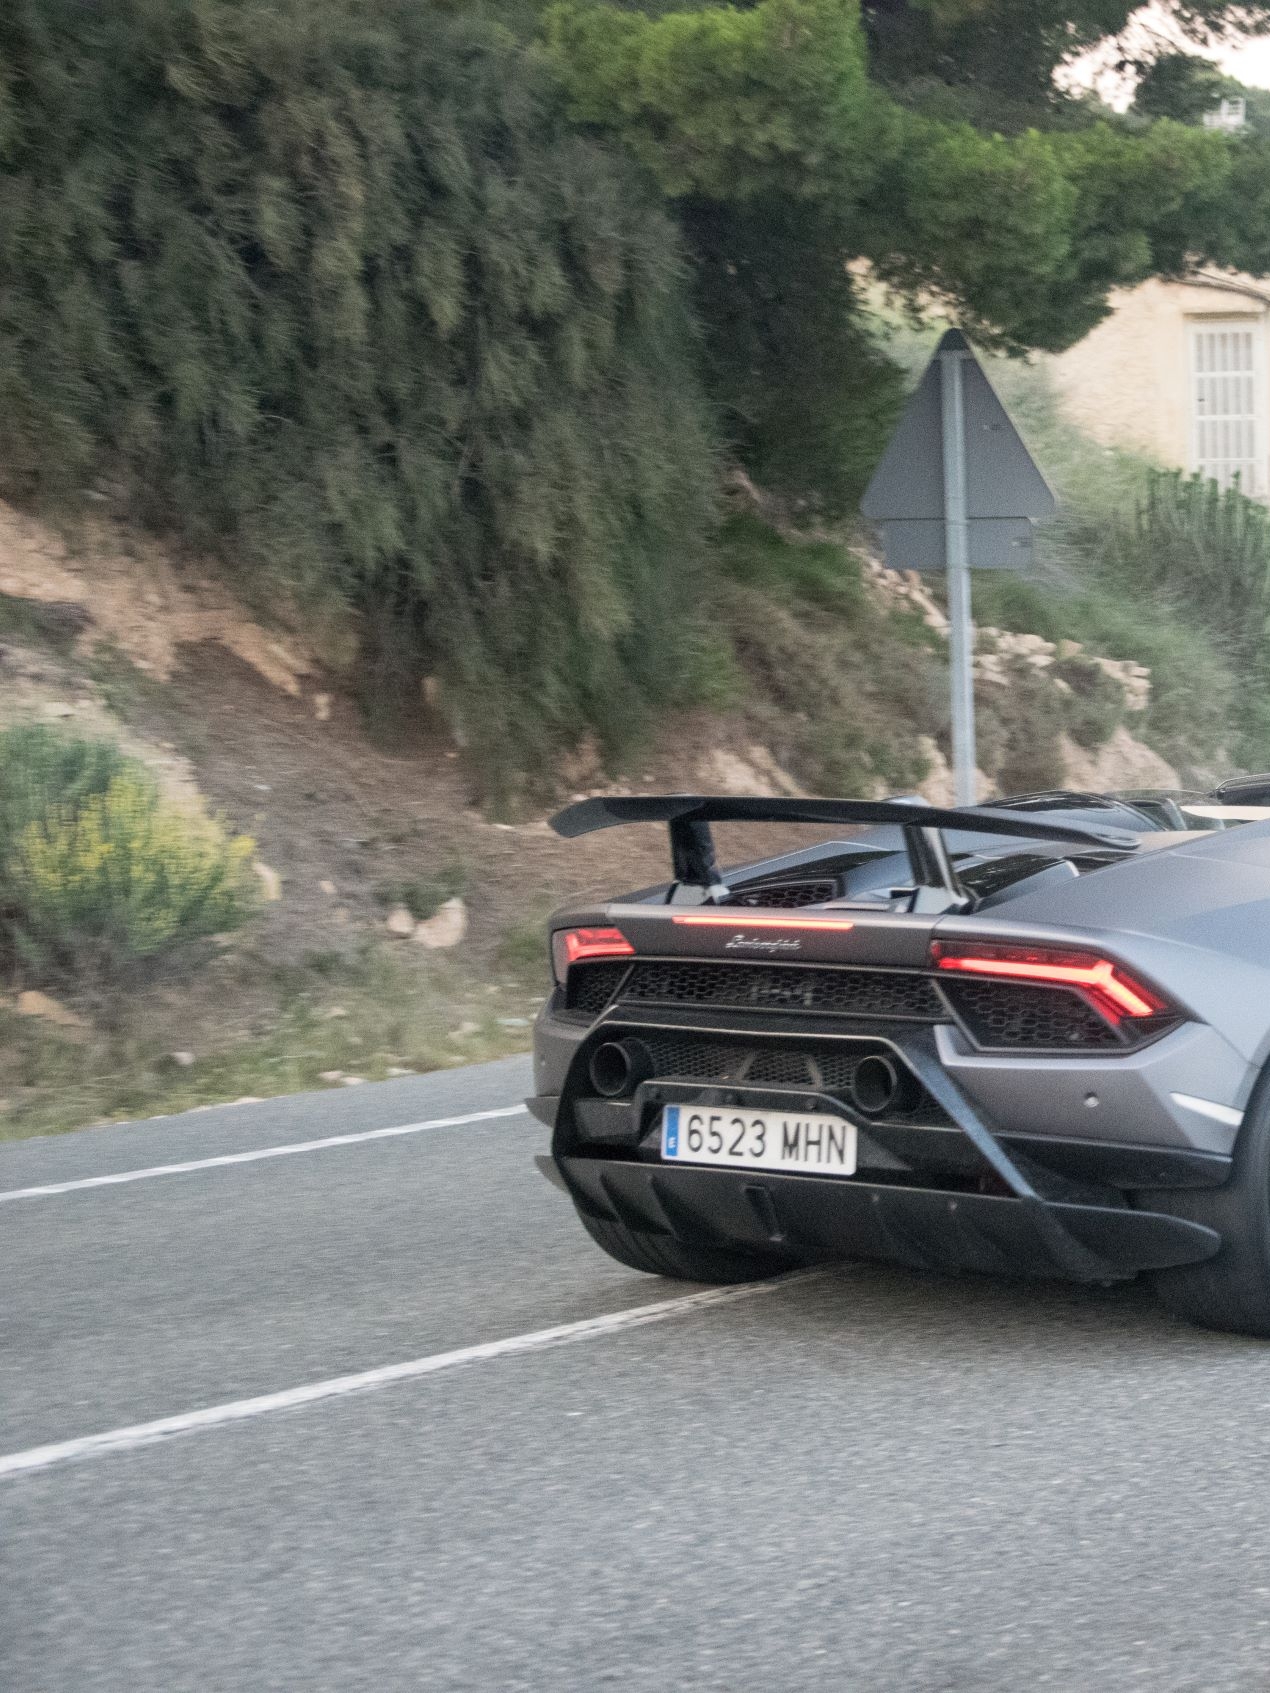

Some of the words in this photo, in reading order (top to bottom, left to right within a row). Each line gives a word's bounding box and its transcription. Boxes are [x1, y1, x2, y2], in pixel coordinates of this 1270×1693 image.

[668, 1136, 677, 1149] E
[687, 1114, 767, 1158] 6523
[780, 1119, 847, 1165] MHN
